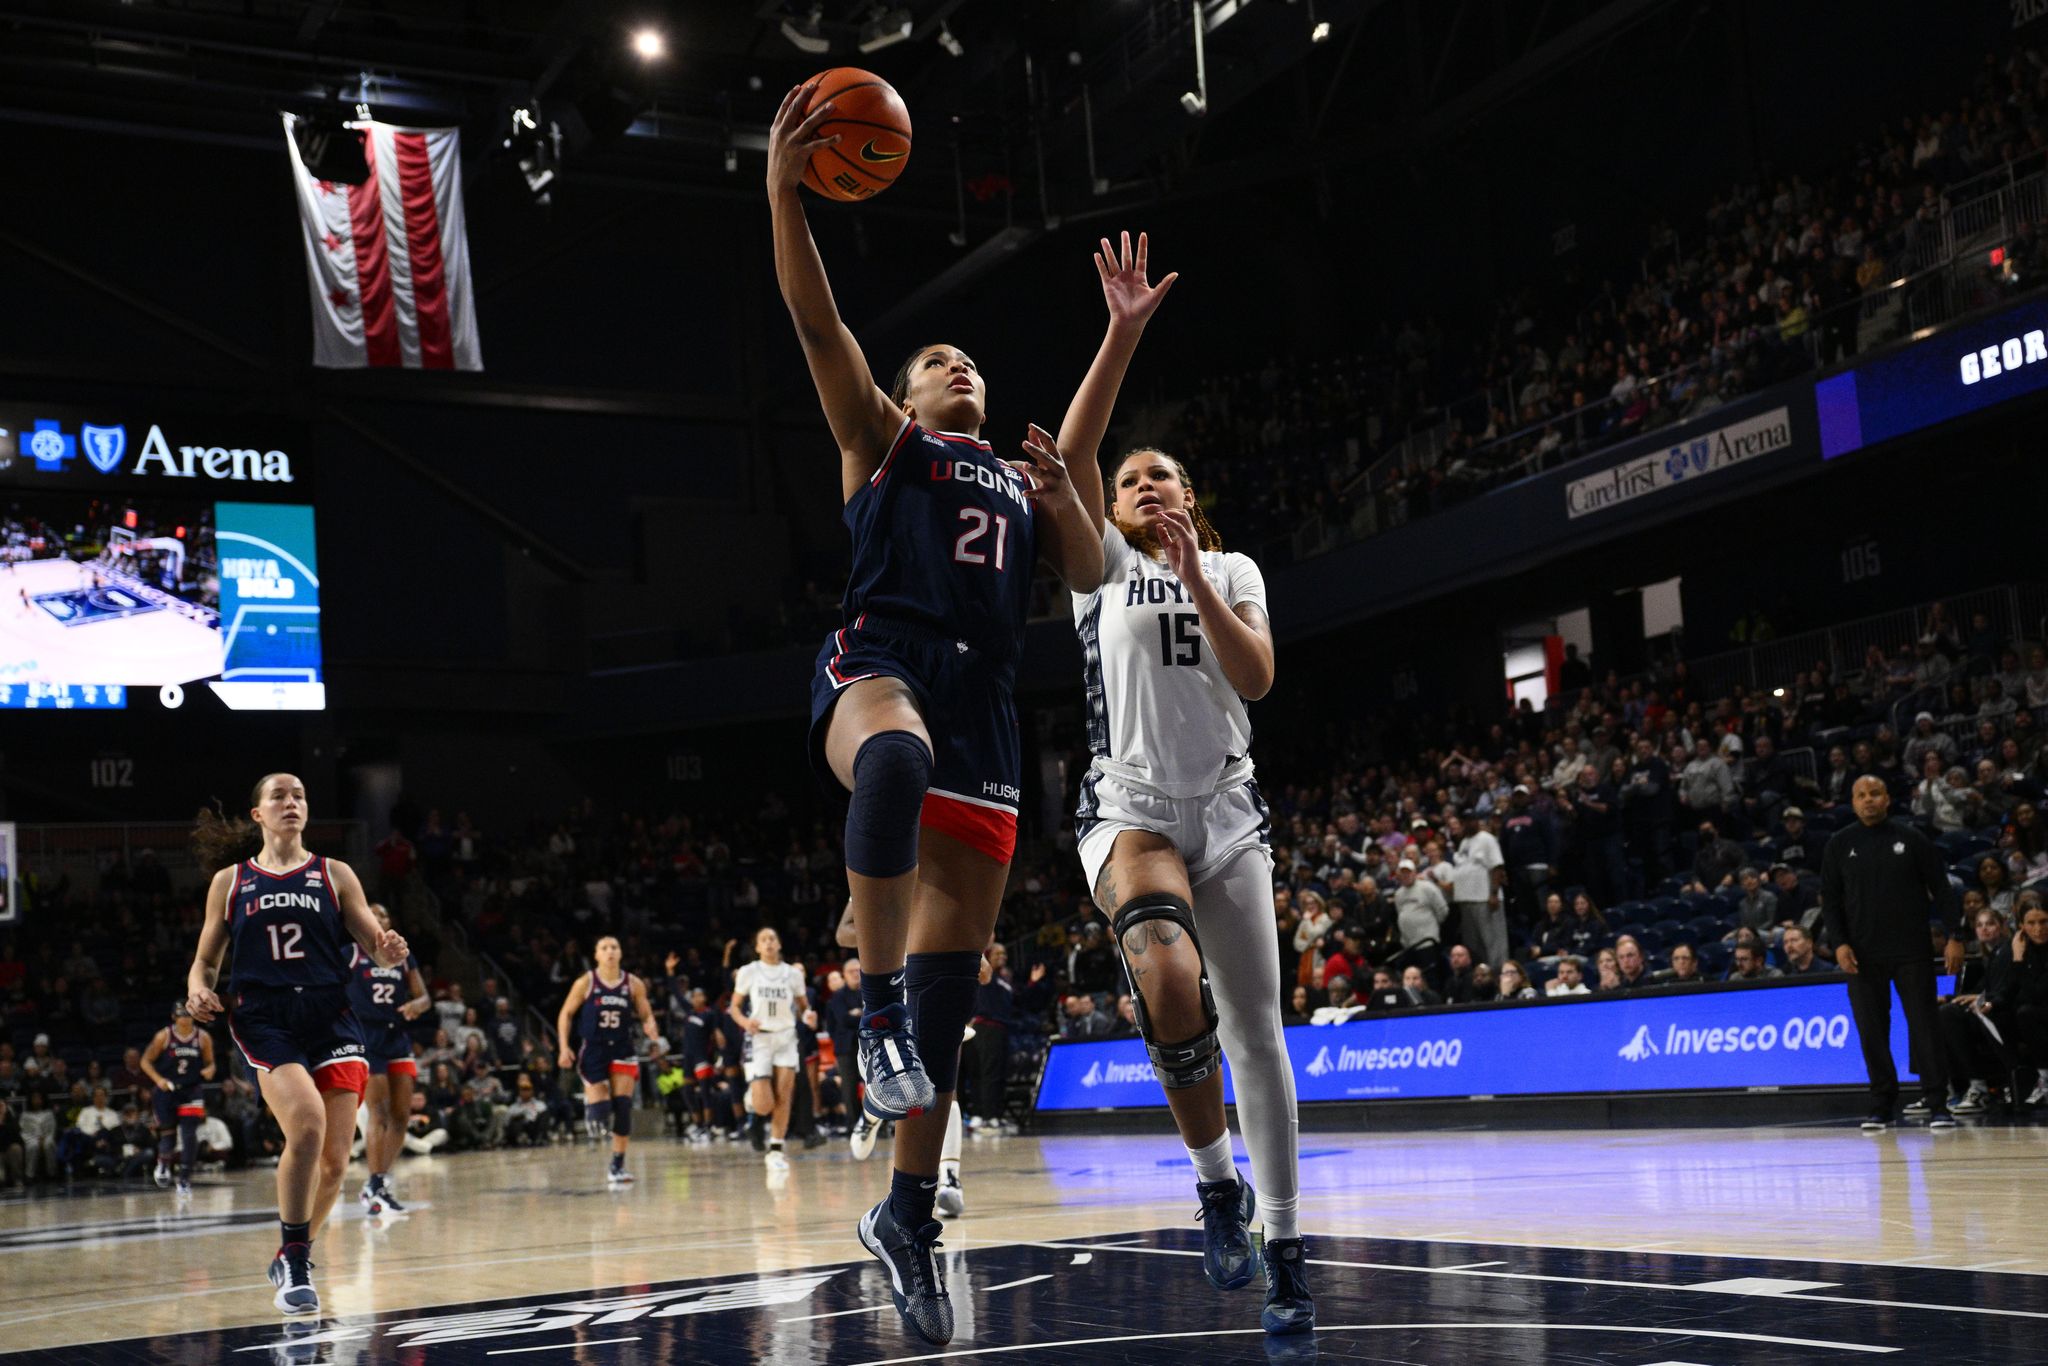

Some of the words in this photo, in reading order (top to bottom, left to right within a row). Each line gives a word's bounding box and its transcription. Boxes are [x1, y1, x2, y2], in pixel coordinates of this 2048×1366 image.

[1960, 329, 2048, 385] GEOR
[132, 424, 294, 483] Arena
[1569, 461, 1660, 514] CareFirst
[1714, 423, 1788, 467] Arena
[931, 460, 1029, 516] UCONN
[954, 507, 1008, 572] 21
[1841, 541, 1881, 582] 105
[1126, 577, 1195, 607] HOY
[1158, 613, 1201, 667] 15
[91, 758, 135, 788] 102
[245, 892, 320, 916] UCONN
[266, 922, 305, 961] 12
[372, 983, 395, 1004] 22
[599, 1010, 621, 1029] 35
[1664, 1023, 1778, 1055] Invesco
[1782, 1014, 1850, 1050] QQQ
[1337, 1044, 1414, 1071] Invesco
[1415, 1038, 1463, 1068] QQQ
